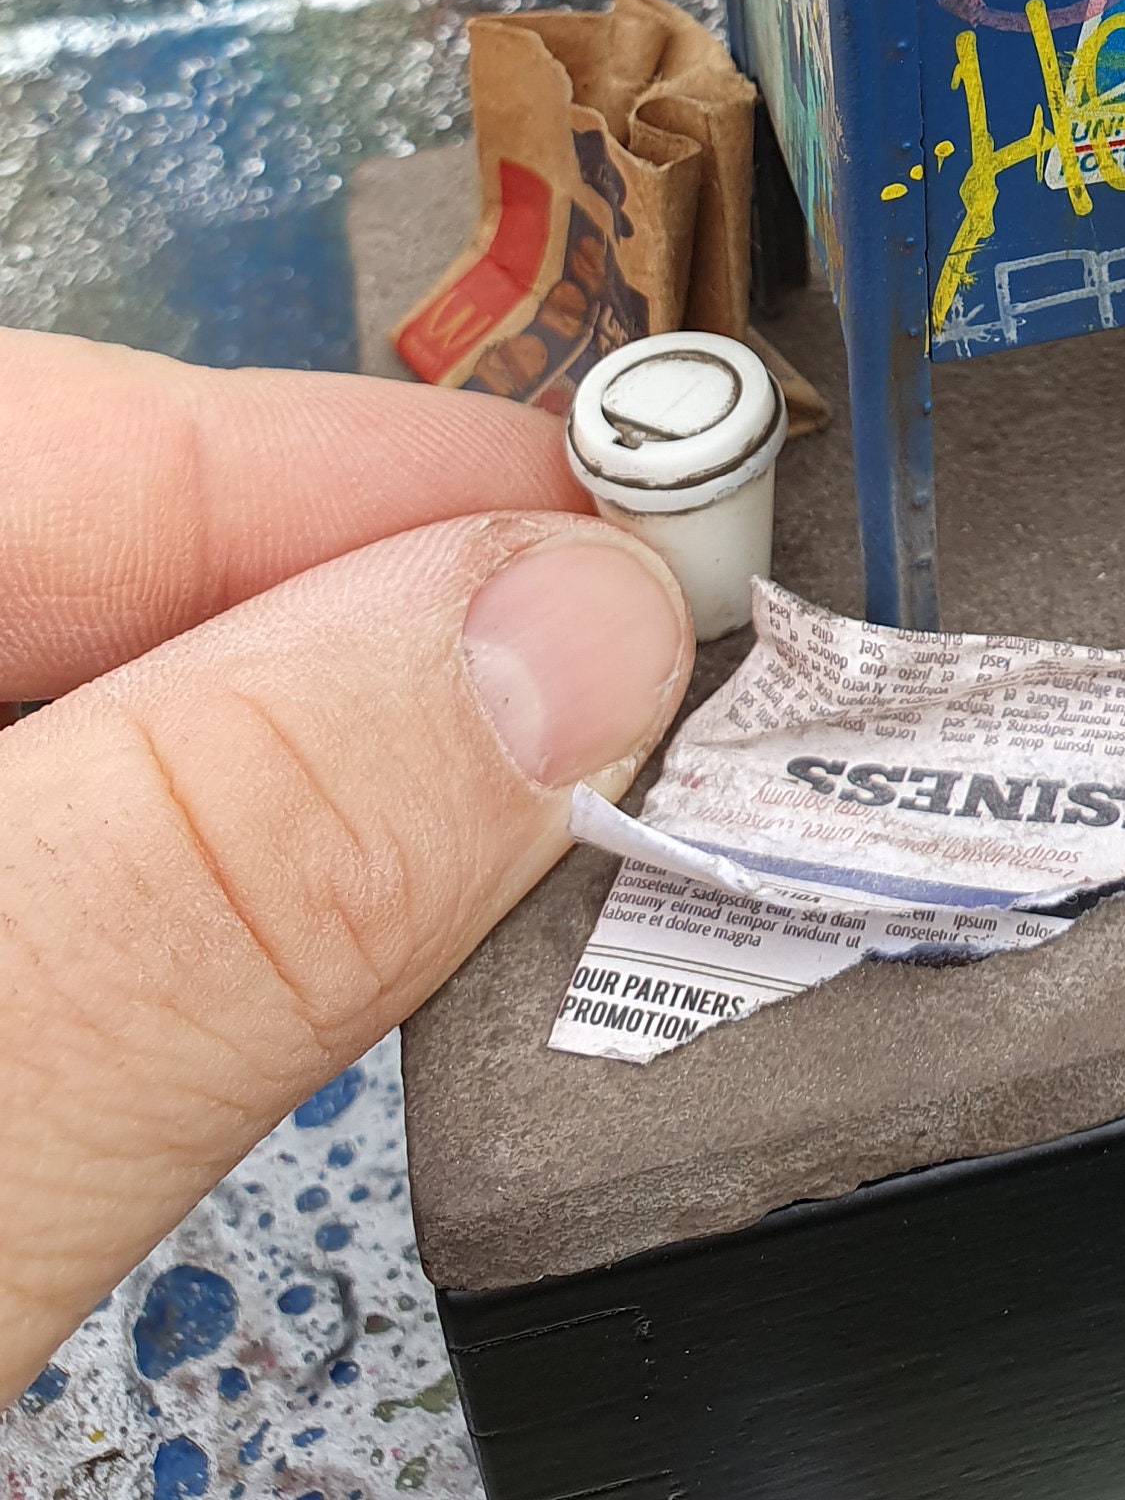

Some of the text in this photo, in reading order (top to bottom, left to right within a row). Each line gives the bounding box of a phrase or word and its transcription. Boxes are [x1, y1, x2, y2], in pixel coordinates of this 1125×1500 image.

[768, 601, 791, 626] kasd
[811, 623, 834, 646] clita
[807, 639, 849, 670] dolores
[858, 639, 887, 660] Stet
[860, 661, 888, 678] duo
[980, 654, 1011, 672] kasd
[766, 659, 795, 690] dolore
[823, 665, 841, 684] eos
[898, 666, 933, 682] justo
[941, 669, 955, 683] et
[841, 677, 871, 693] vero
[890, 681, 949, 697] voluptua.
[736, 689, 757, 707] sed
[1003, 688, 1017, 702] et
[1026, 690, 1068, 711] labore
[946, 700, 994, 718] tempor
[1001, 706, 1049, 722] eirmod
[1080, 699, 1093, 711] ut
[942, 716, 965, 730] sed
[1056, 710, 1111, 726] nonumy
[875, 725, 916, 742] Lorem
[939, 730, 976, 746] amet,
[1006, 719, 1074, 739] sadipscing
[983, 733, 999, 748] sit
[1008, 735, 1044, 752] dolor
[1053, 739, 1094, 757] ipsum
[616, 874, 688, 897] consetetur
[691, 886, 762, 914] sadipscing
[830, 911, 867, 931] diam
[601, 905, 762, 948] labore et dolore magna
[609, 890, 861, 949] nonumy eirmod tempor invidunt ut
[953, 912, 997, 931] ipsum
[571, 965, 746, 1018] OUR PARTNERS
[558, 994, 700, 1043] PROMOTION
